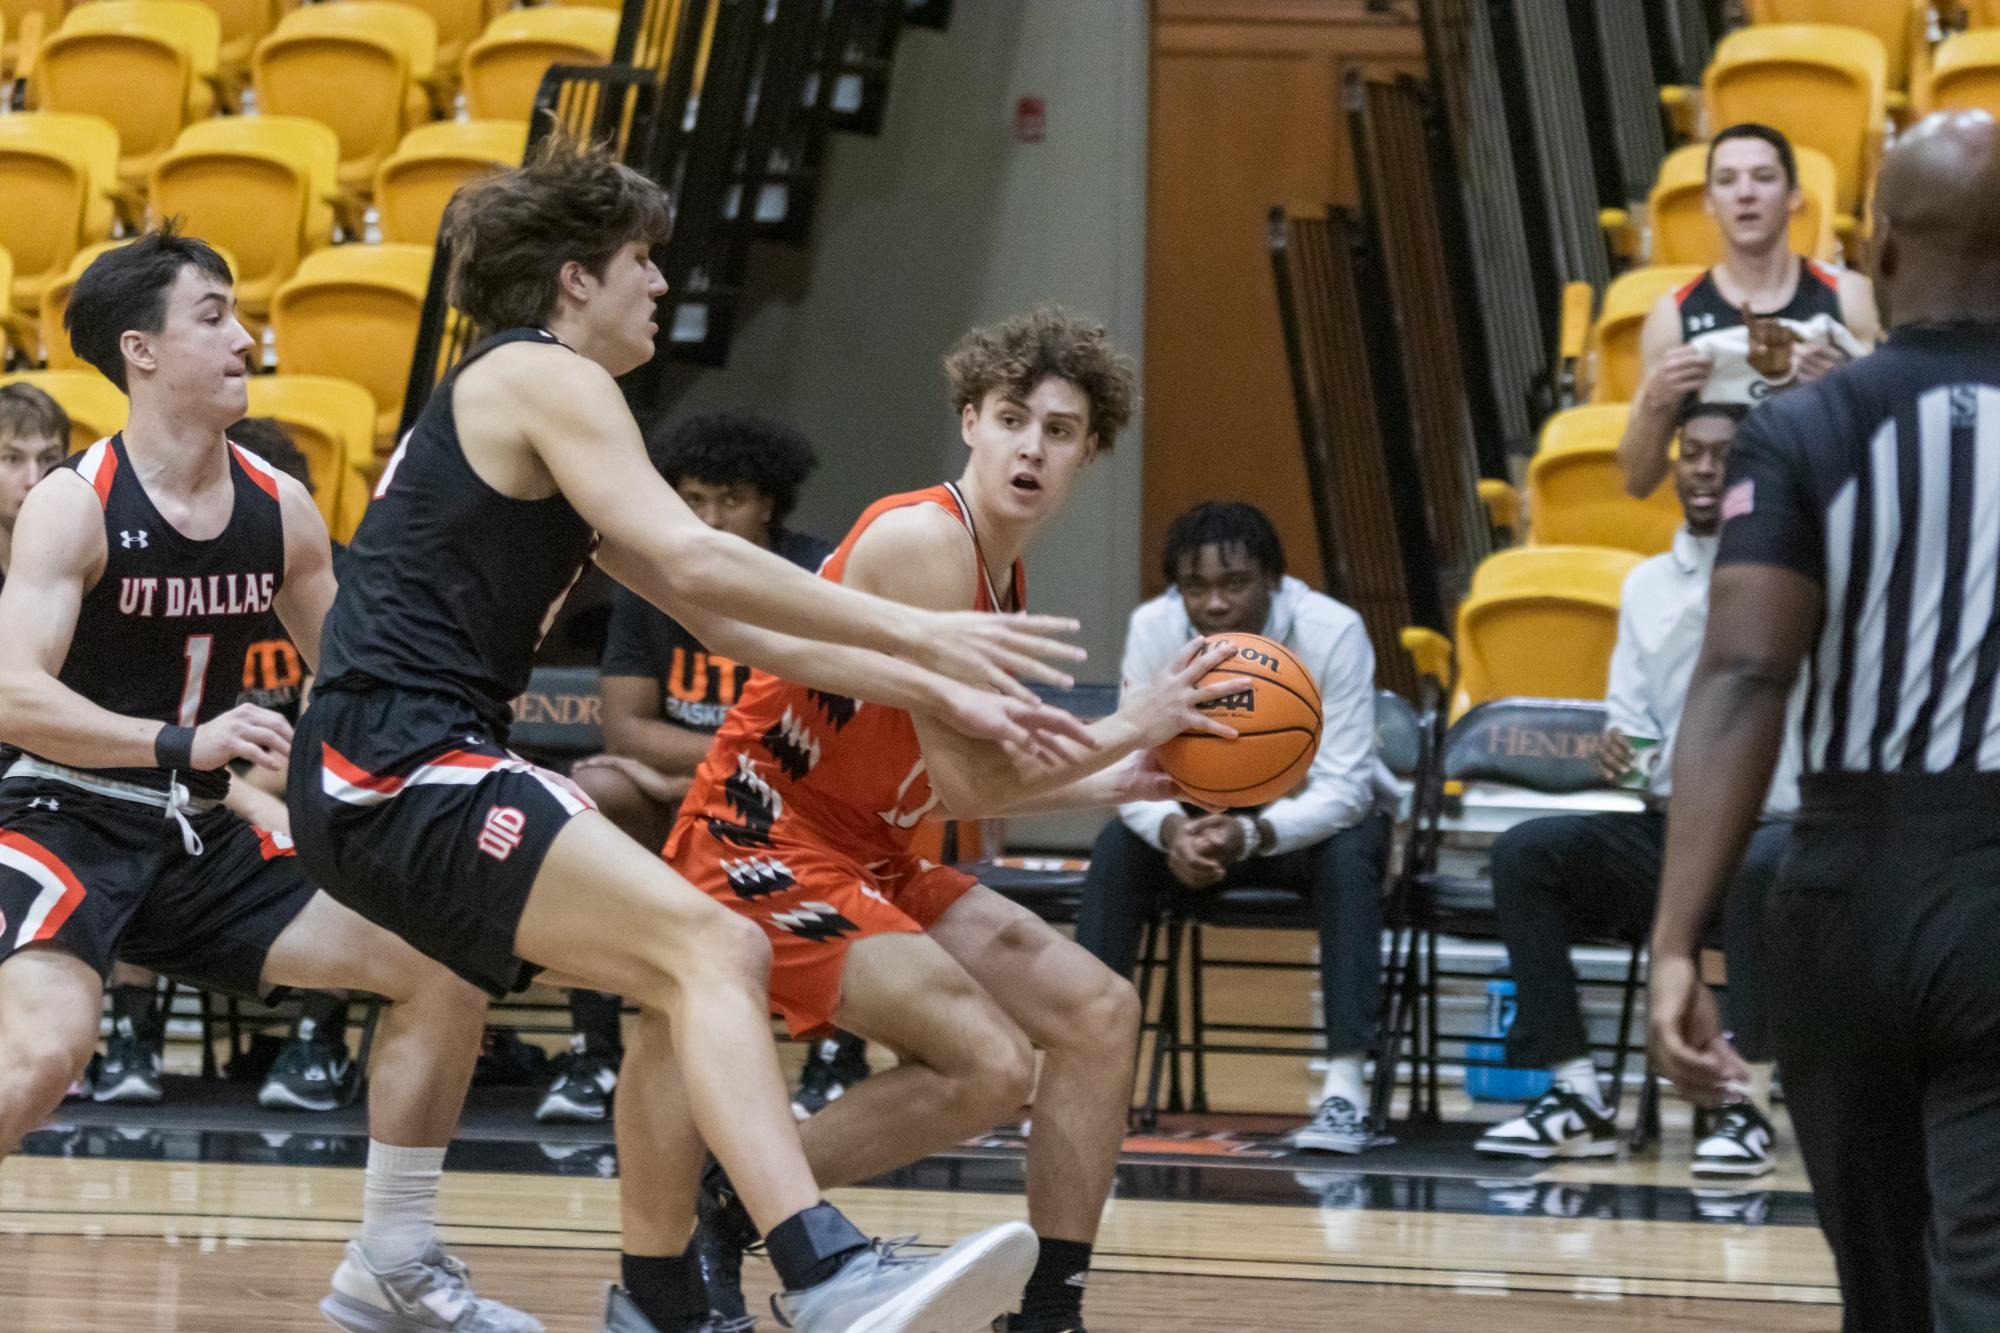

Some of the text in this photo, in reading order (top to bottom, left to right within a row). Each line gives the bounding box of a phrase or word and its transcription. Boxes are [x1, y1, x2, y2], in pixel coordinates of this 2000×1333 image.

[119, 572, 274, 617] UT DALLAS
[178, 634, 215, 728] 1
